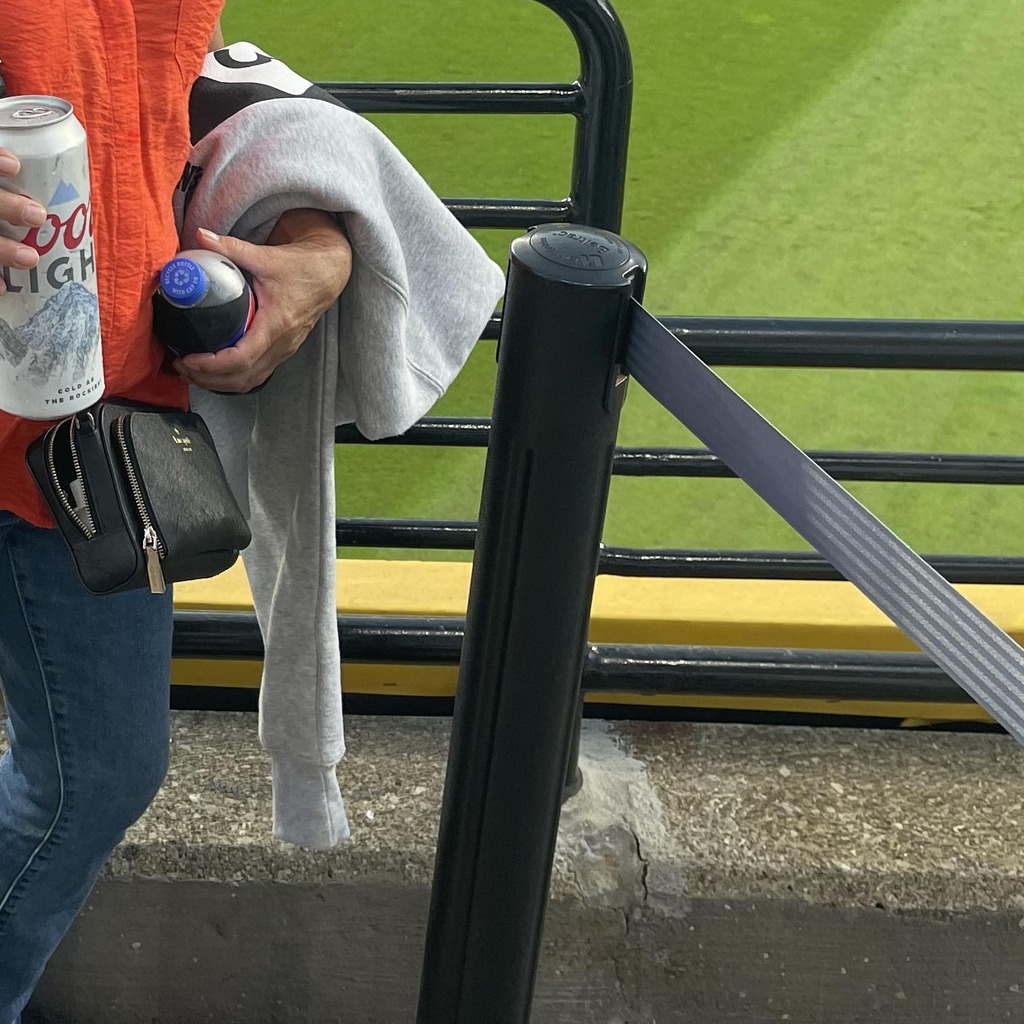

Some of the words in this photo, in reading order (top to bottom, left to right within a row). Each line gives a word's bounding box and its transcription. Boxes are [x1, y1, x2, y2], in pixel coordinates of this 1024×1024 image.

[176, 261, 196, 271] BOTTLE
[172, 287, 186, 295] WITH
[185, 283, 195, 294] CAP
[57, 383, 82, 394] COLD
[45, 397, 64, 405] THE
